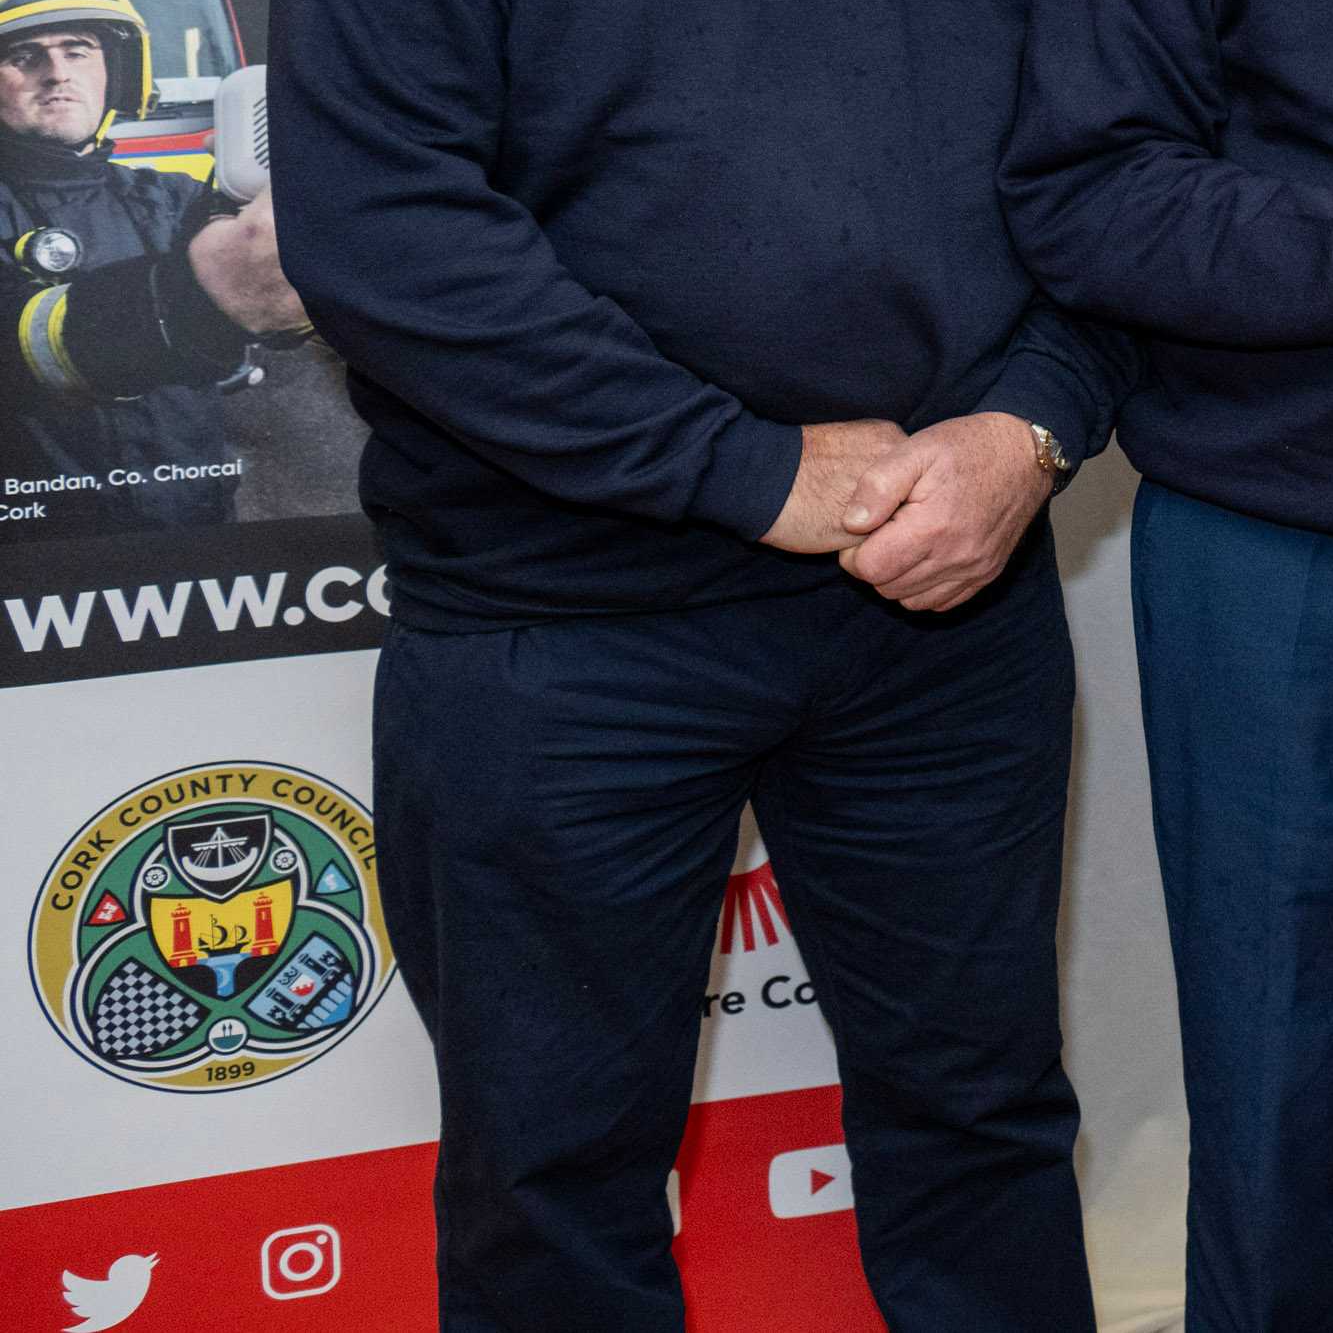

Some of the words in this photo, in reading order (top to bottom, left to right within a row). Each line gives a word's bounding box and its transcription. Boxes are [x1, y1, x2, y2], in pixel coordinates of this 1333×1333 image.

[4, 473, 102, 495] Bandan,
[108, 468, 148, 486] Co.
[52, 829, 116, 912] CORK
[119, 772, 259, 828] COUNTY
[271, 777, 377, 871] COUNCIL
[205, 1060, 256, 1083] 1899
